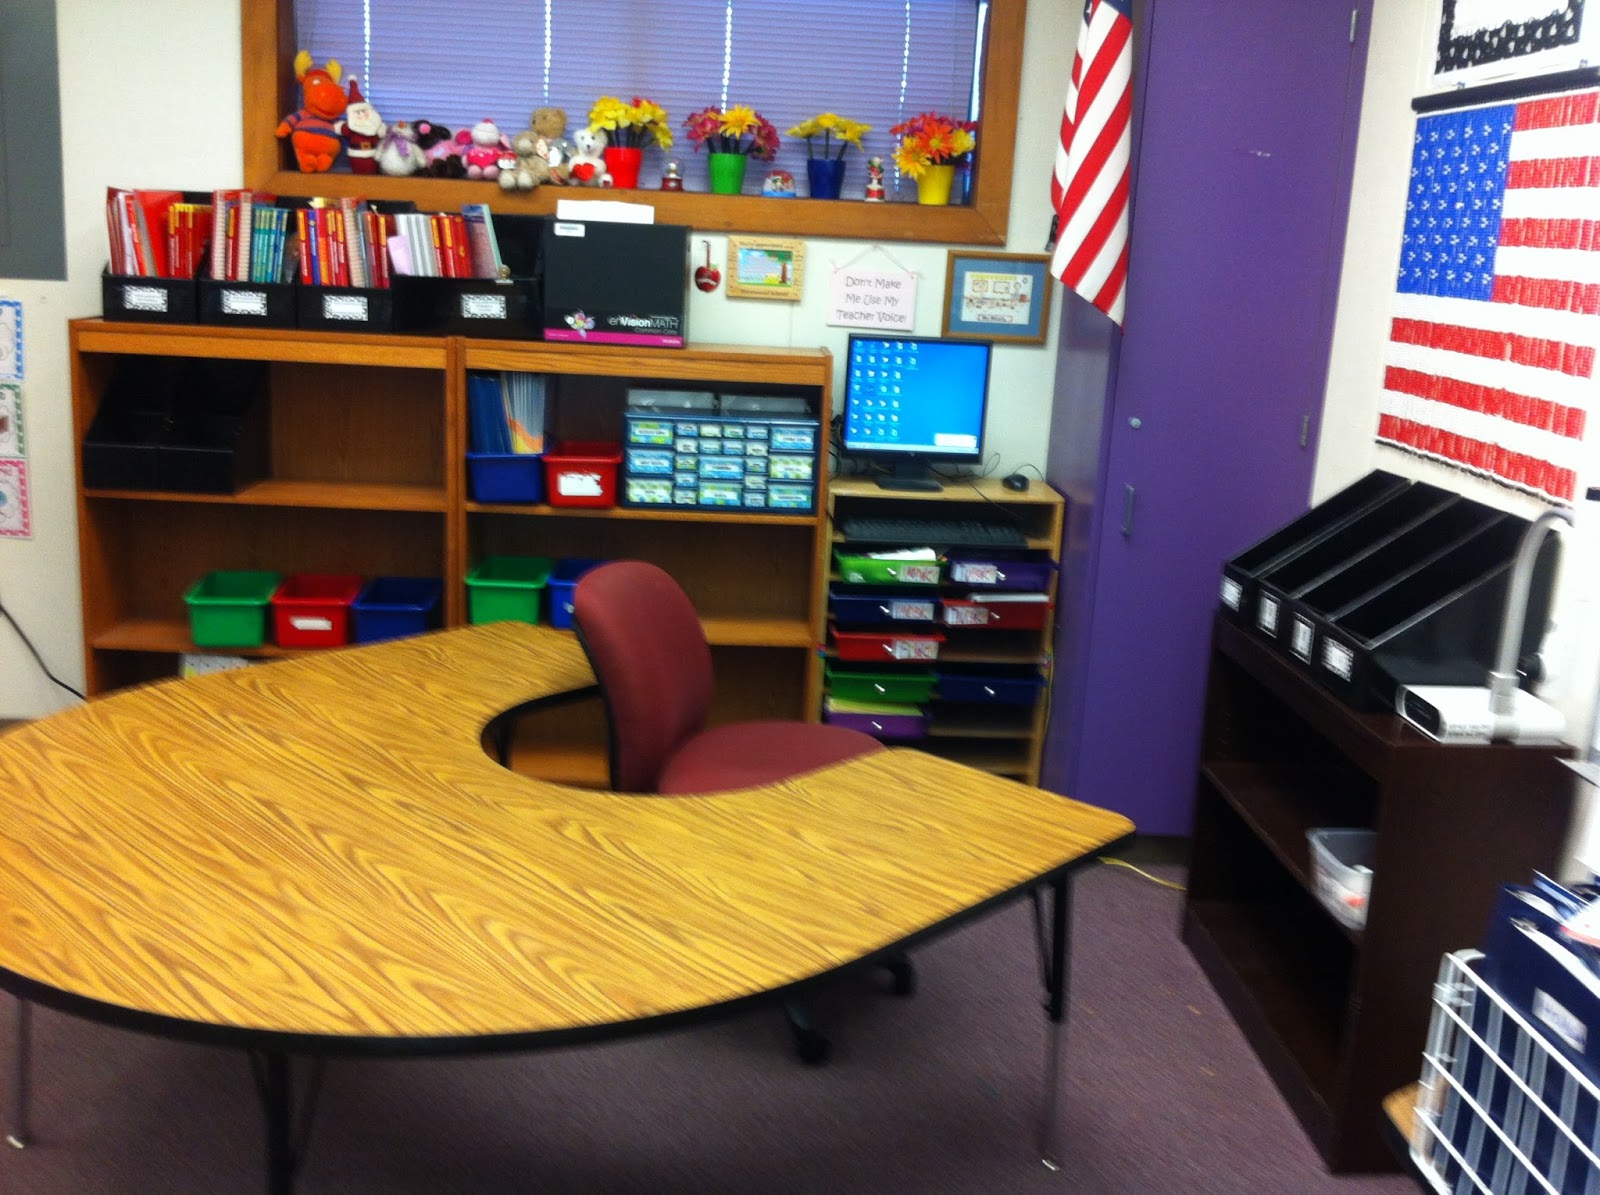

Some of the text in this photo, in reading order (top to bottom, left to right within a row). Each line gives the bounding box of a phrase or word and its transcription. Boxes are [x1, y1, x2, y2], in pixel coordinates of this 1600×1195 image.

[845, 275, 902, 290] Don't Make
[845, 293, 900, 307] Me Use My
[836, 309, 875, 321] Teacher
